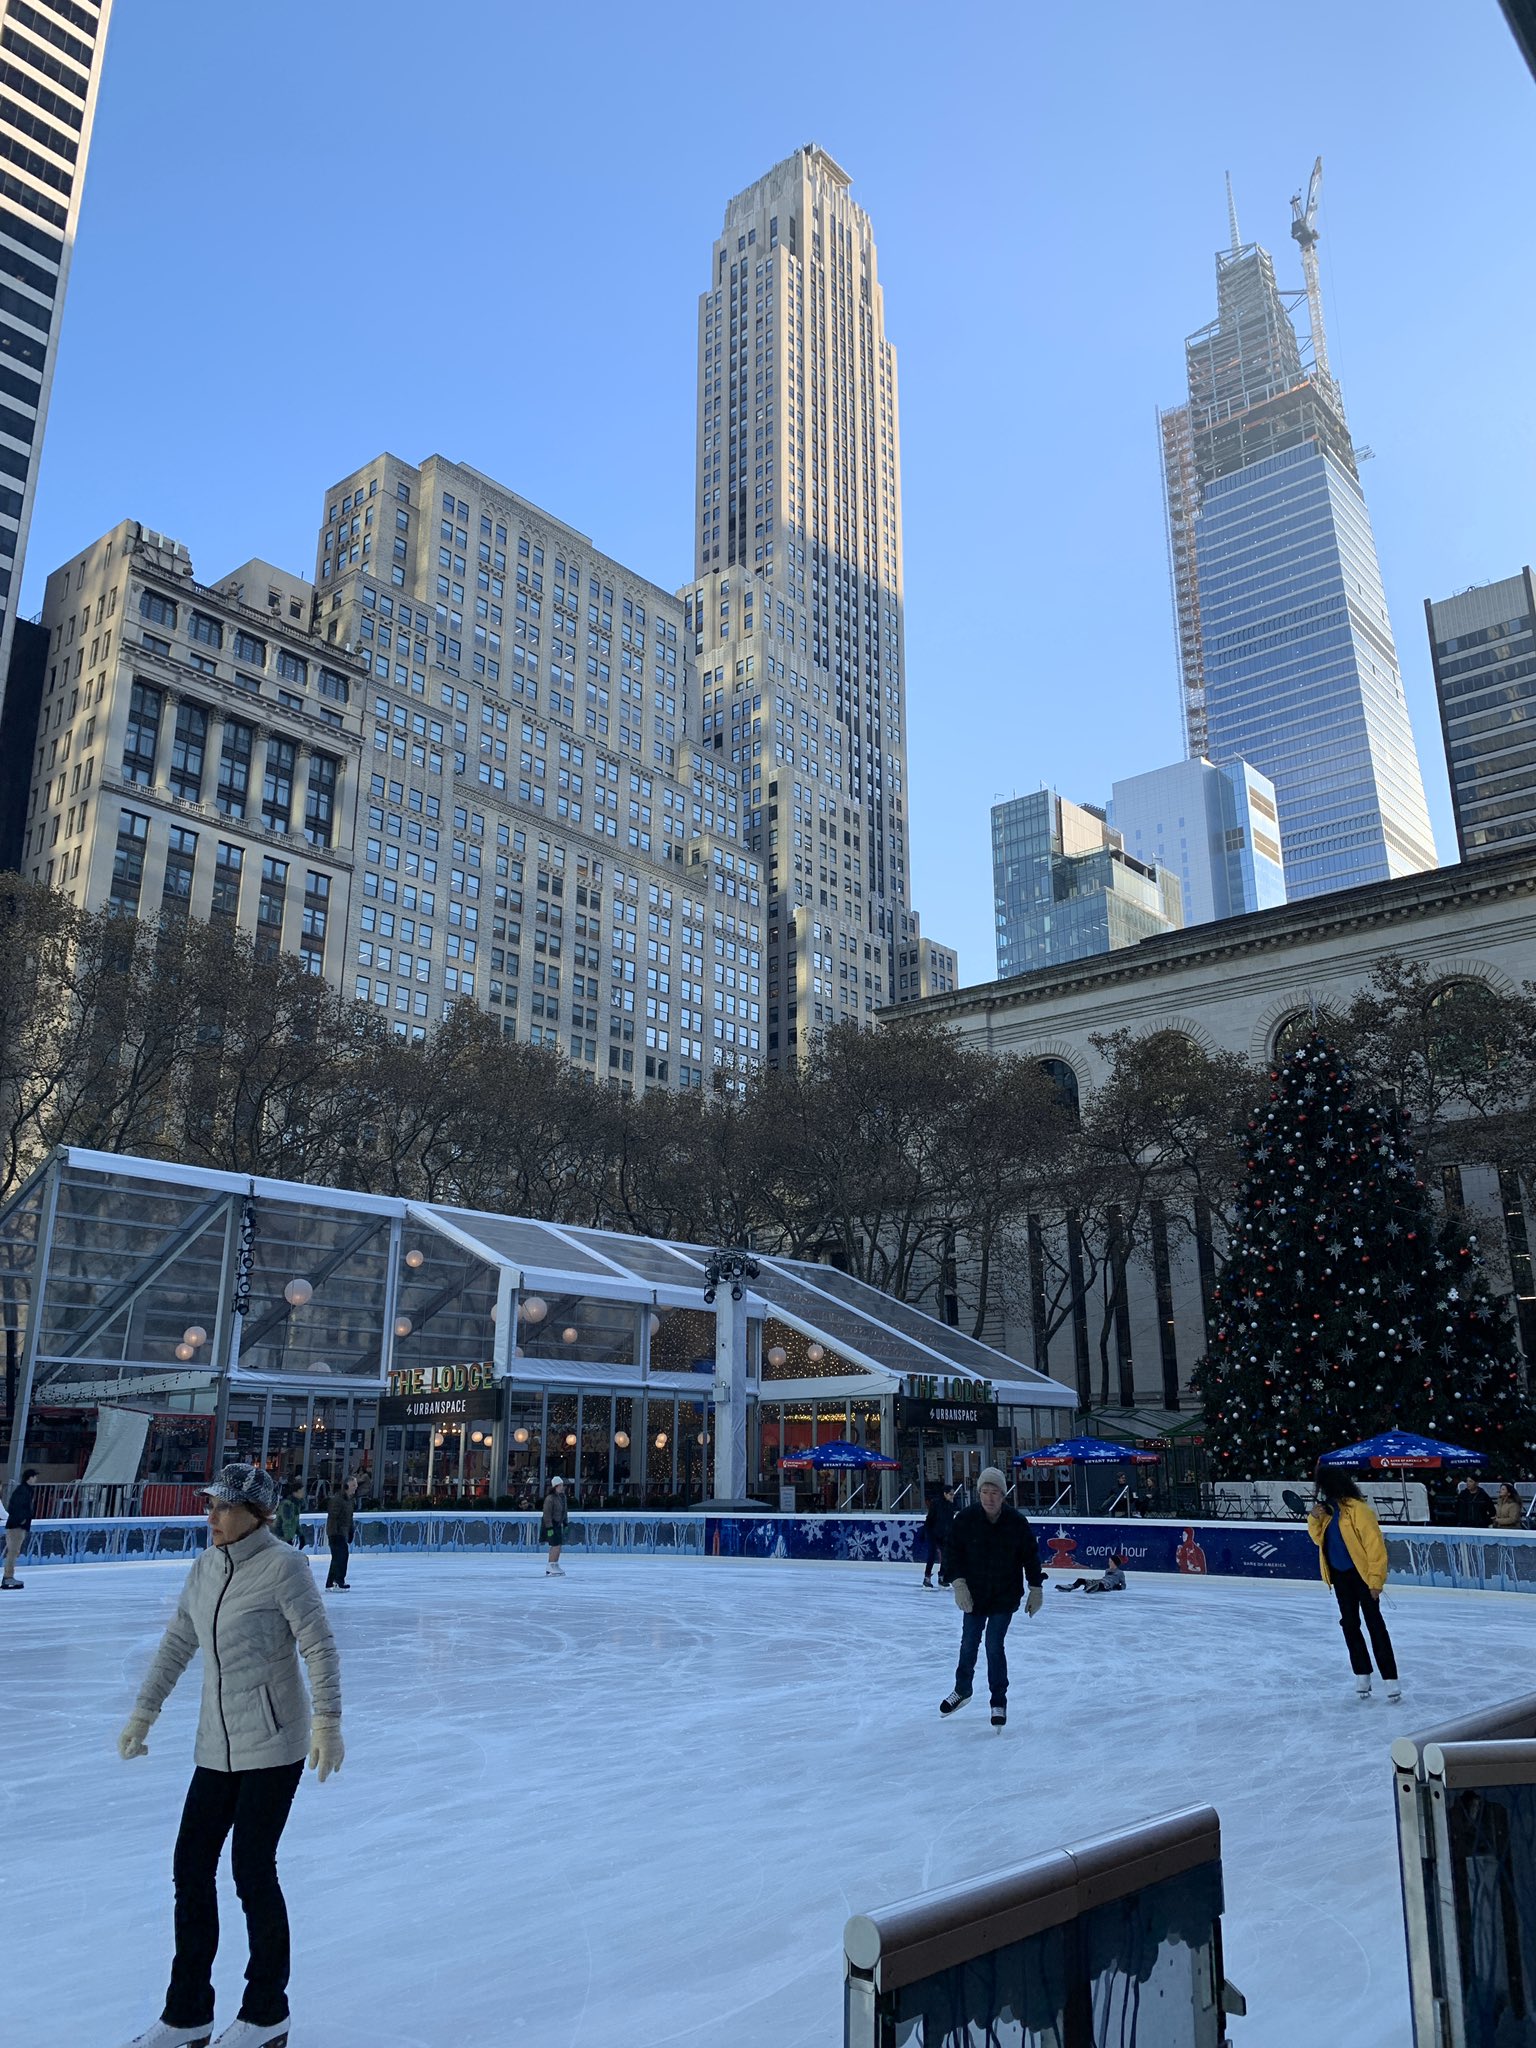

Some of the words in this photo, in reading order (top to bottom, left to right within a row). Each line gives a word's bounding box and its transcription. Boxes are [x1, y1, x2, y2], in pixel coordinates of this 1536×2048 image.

[388, 1368, 425, 1397] THE
[431, 1361, 495, 1393] LODGE
[906, 1373, 939, 1399] THE
[943, 1376, 993, 1403] LODGE
[413, 1399, 467, 1416] URBANSPACE
[935, 1408, 978, 1422] URBANSPACE
[1120, 1543, 1148, 1558] hour
